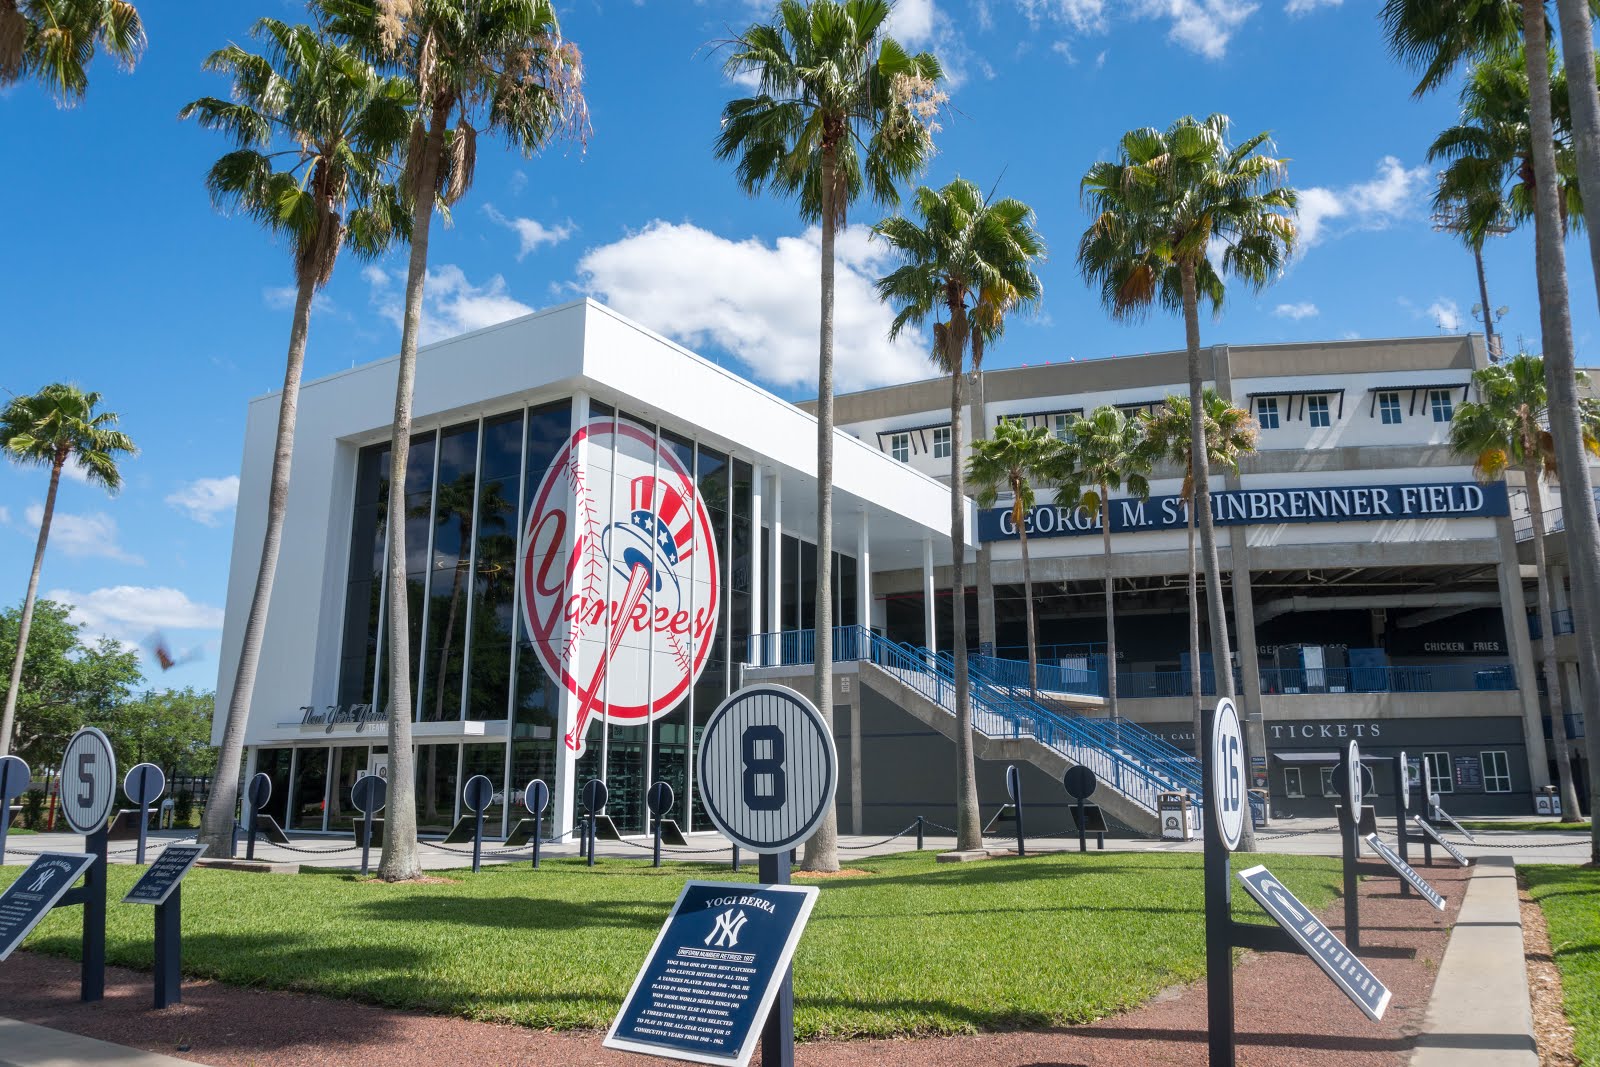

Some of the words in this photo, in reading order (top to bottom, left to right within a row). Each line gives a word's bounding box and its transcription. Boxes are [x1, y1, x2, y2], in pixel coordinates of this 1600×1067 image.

[1121, 501, 1153, 527] M.
[1401, 484, 1484, 512] FIELD
[526, 508, 713, 641] Yankees
[1424, 642, 1465, 652] CHICKEN
[1473, 641, 1499, 651] FRIES
[326, 704, 356, 734] York
[368, 723, 386, 732] TEAM
[1271, 724, 1380, 738] TICKETS
[743, 725, 785, 811] 8
[1221, 733, 1239, 811] 16
[77, 754, 95, 808] 5
[705, 896, 738, 908] YOGI
[738, 896, 776, 914] BERRA
[704, 908, 748, 948] NY
[678, 949, 700, 957] UNIFORM
[720, 952, 742, 960] RETIRED:
[743, 954, 755, 962] 1972
[647, 1010, 675, 1018] THREE-TIME
[708, 1018, 733, 1026] SELECTED
[634, 1027, 667, 1035] CONSECUTIVE
